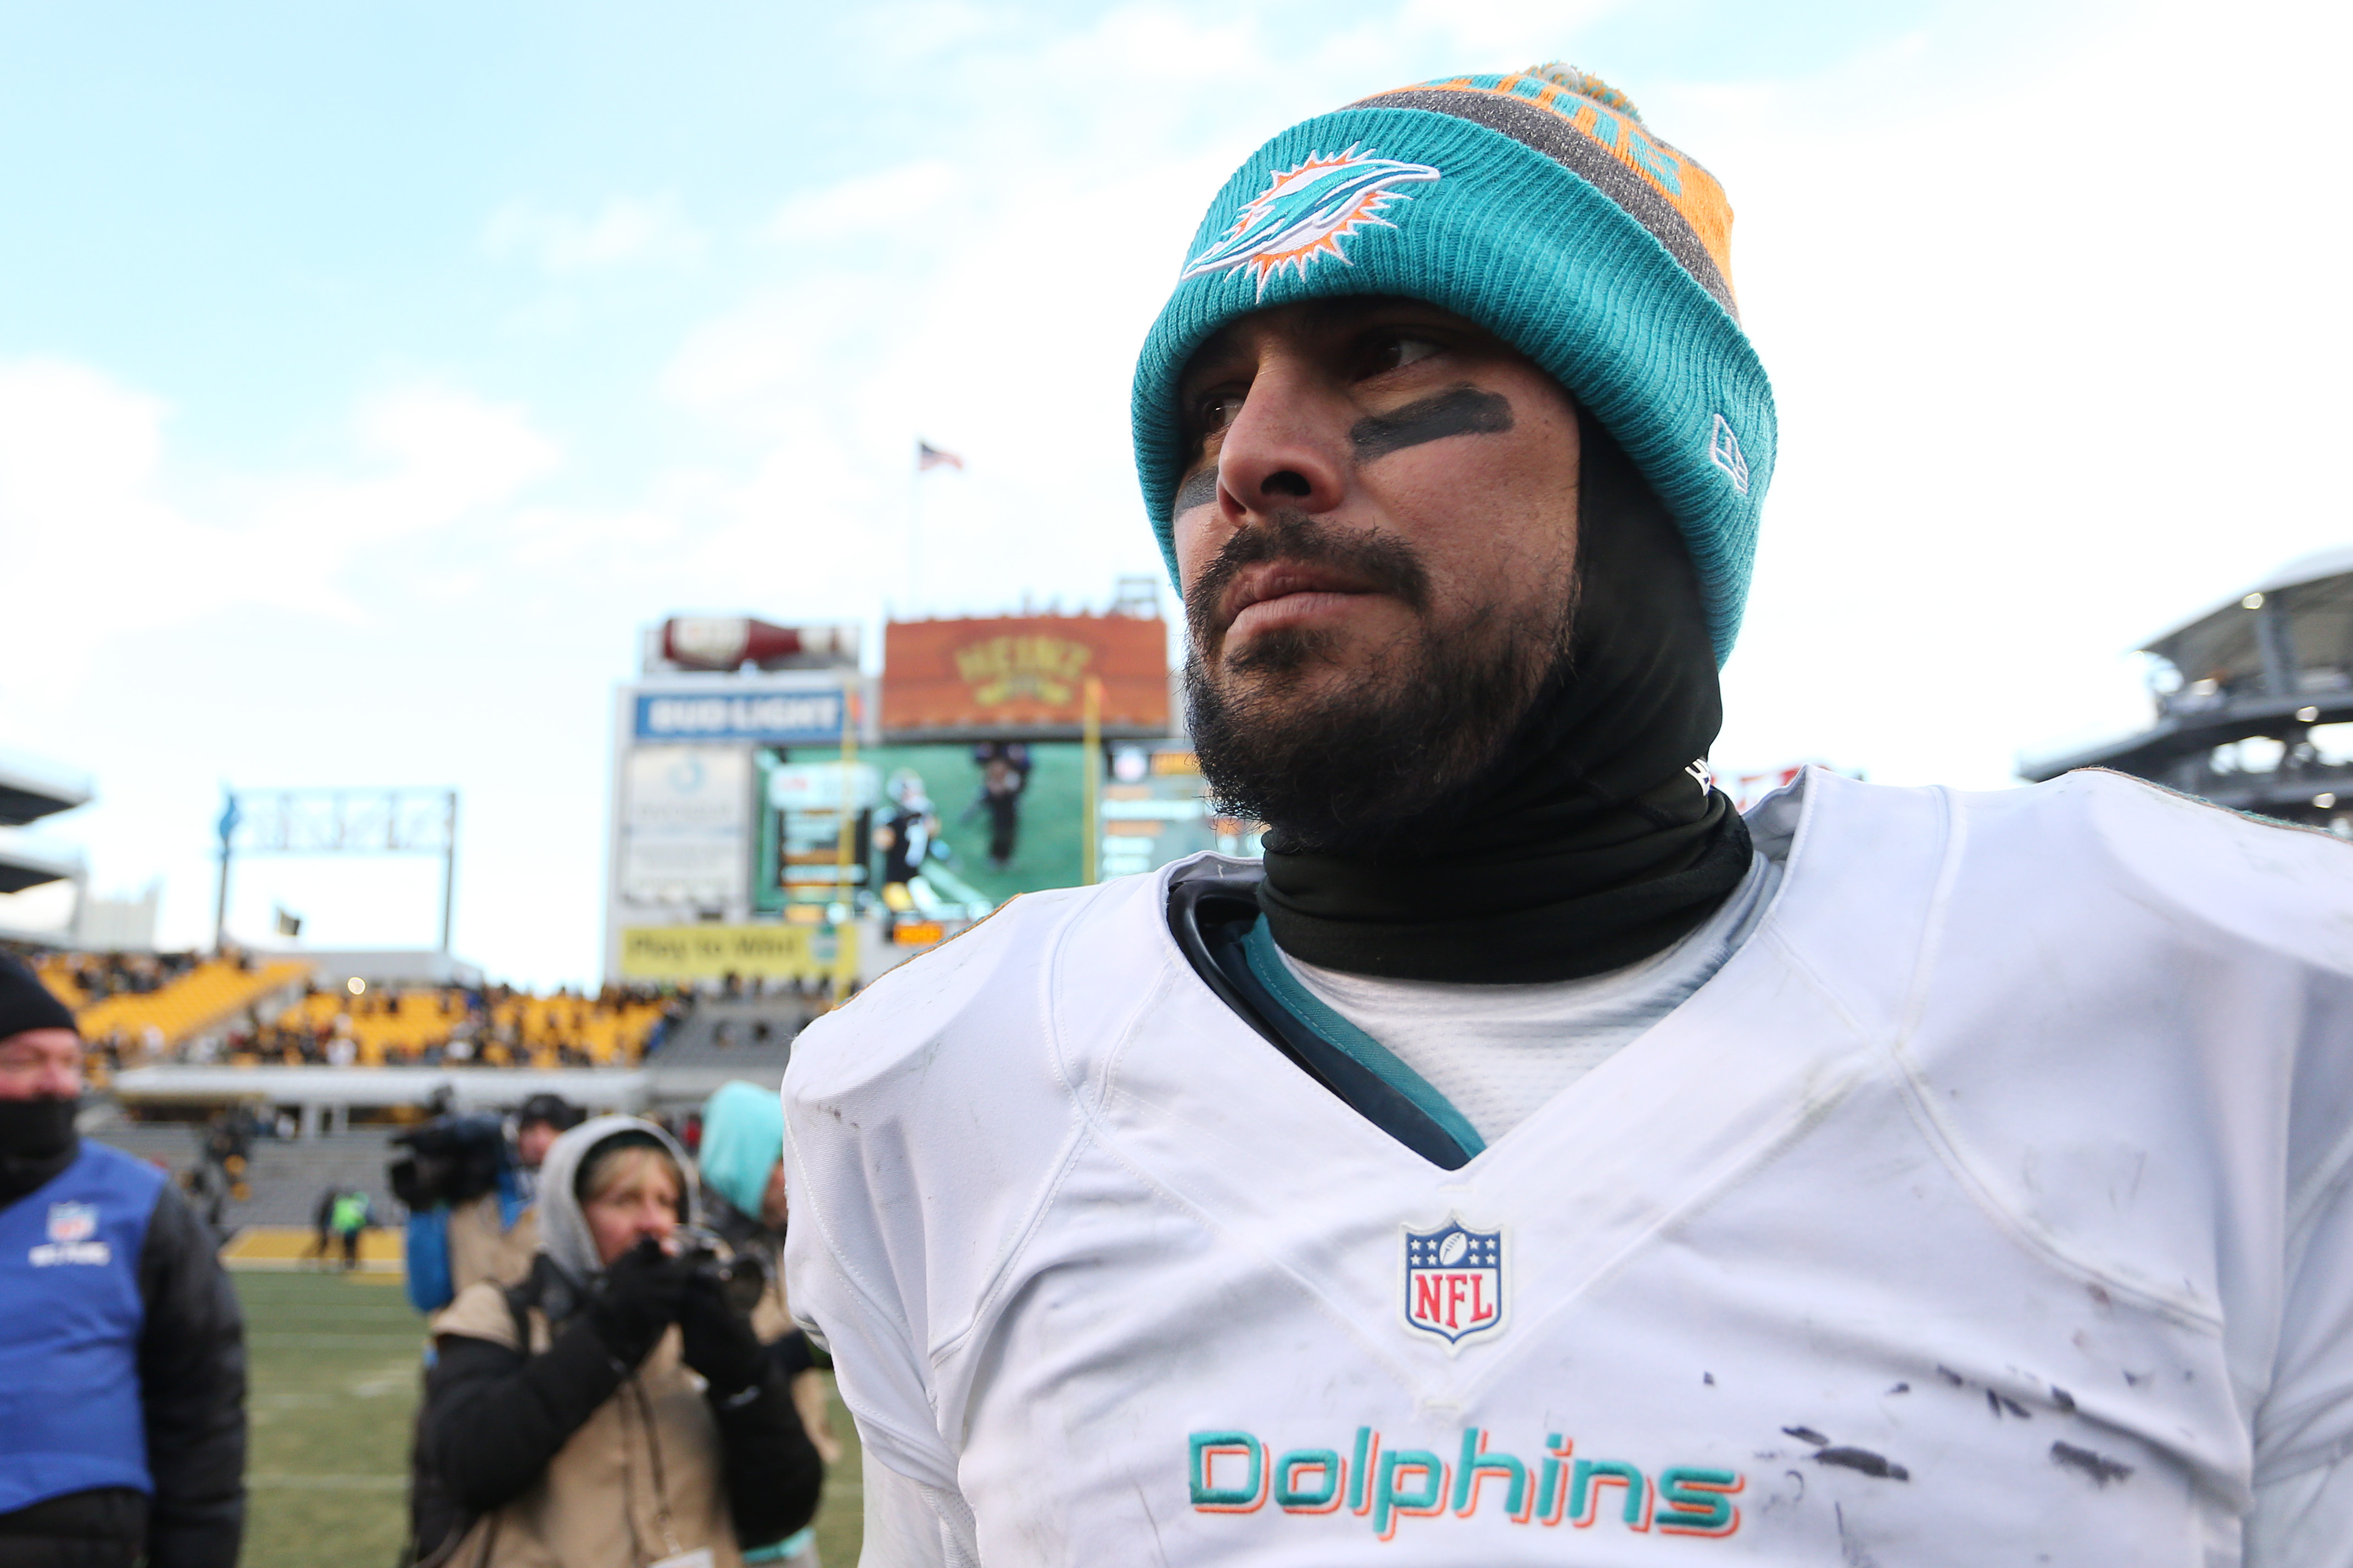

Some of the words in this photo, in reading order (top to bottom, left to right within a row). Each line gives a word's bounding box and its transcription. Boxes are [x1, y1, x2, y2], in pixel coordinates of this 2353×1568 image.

[649, 698, 728, 732] BUD
[732, 695, 839, 731] LIGHT
[628, 936, 687, 960] Play
[1415, 1273, 1494, 1330] NFL
[1189, 1426, 1745, 1541] Dolphins
